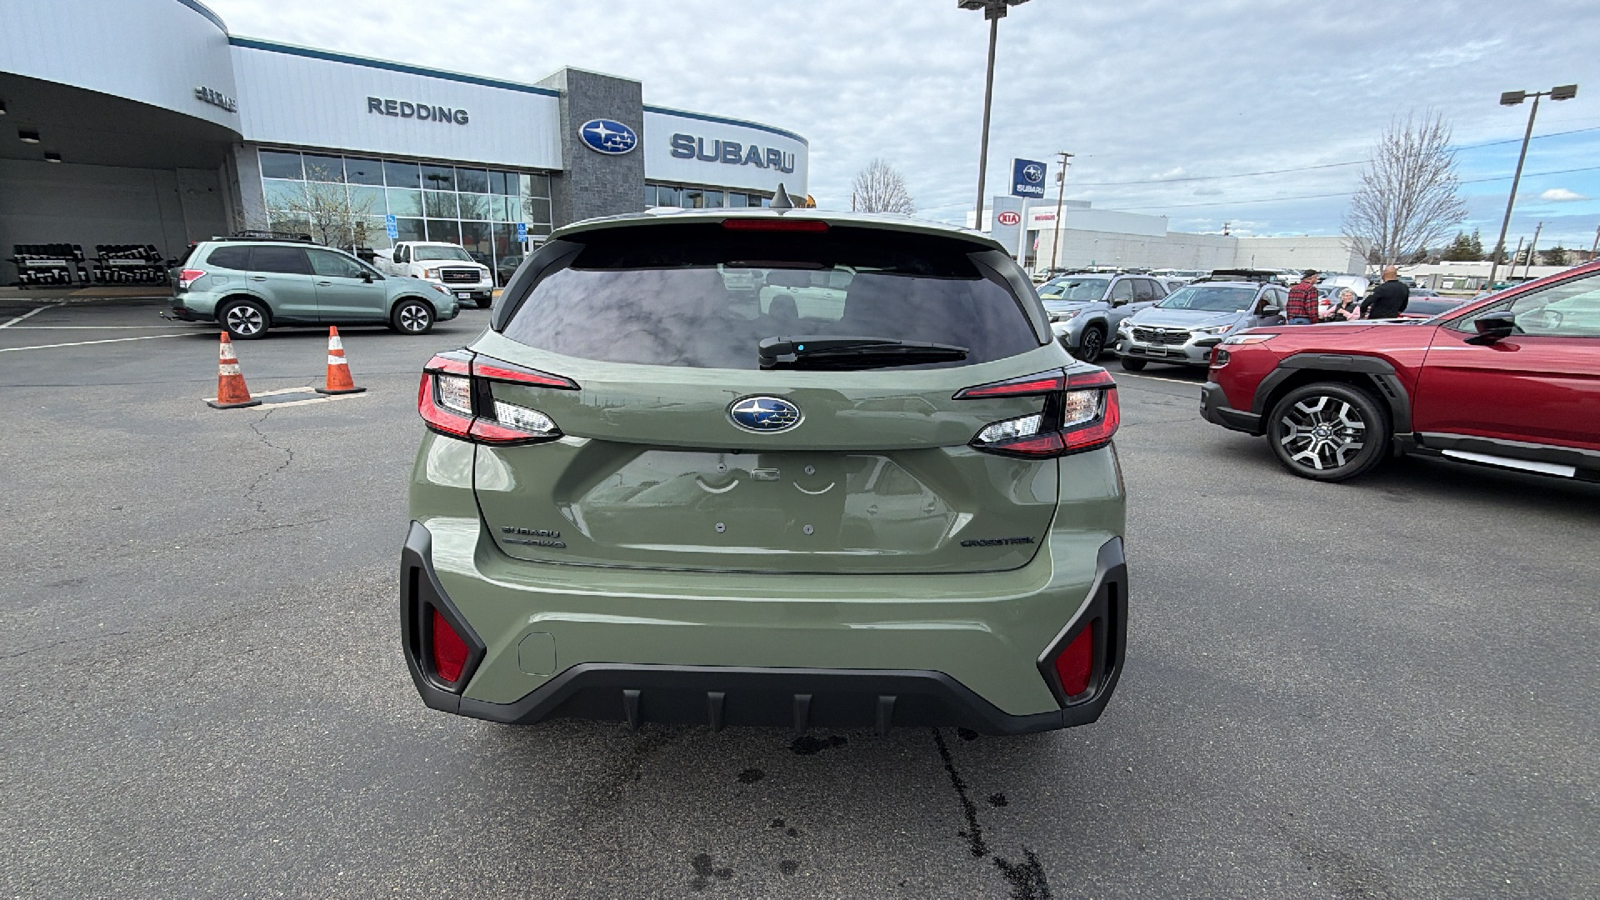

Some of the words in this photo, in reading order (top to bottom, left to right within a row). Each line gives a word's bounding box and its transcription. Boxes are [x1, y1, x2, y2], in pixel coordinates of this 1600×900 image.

[367, 96, 469, 125] REDDING
[670, 133, 795, 173] SUBARU
[1016, 184, 1044, 194] SUBARU
[1001, 213, 1018, 224] KIA
[501, 525, 560, 538] SUBARU
[960, 536, 1036, 547] CROSSTREK
